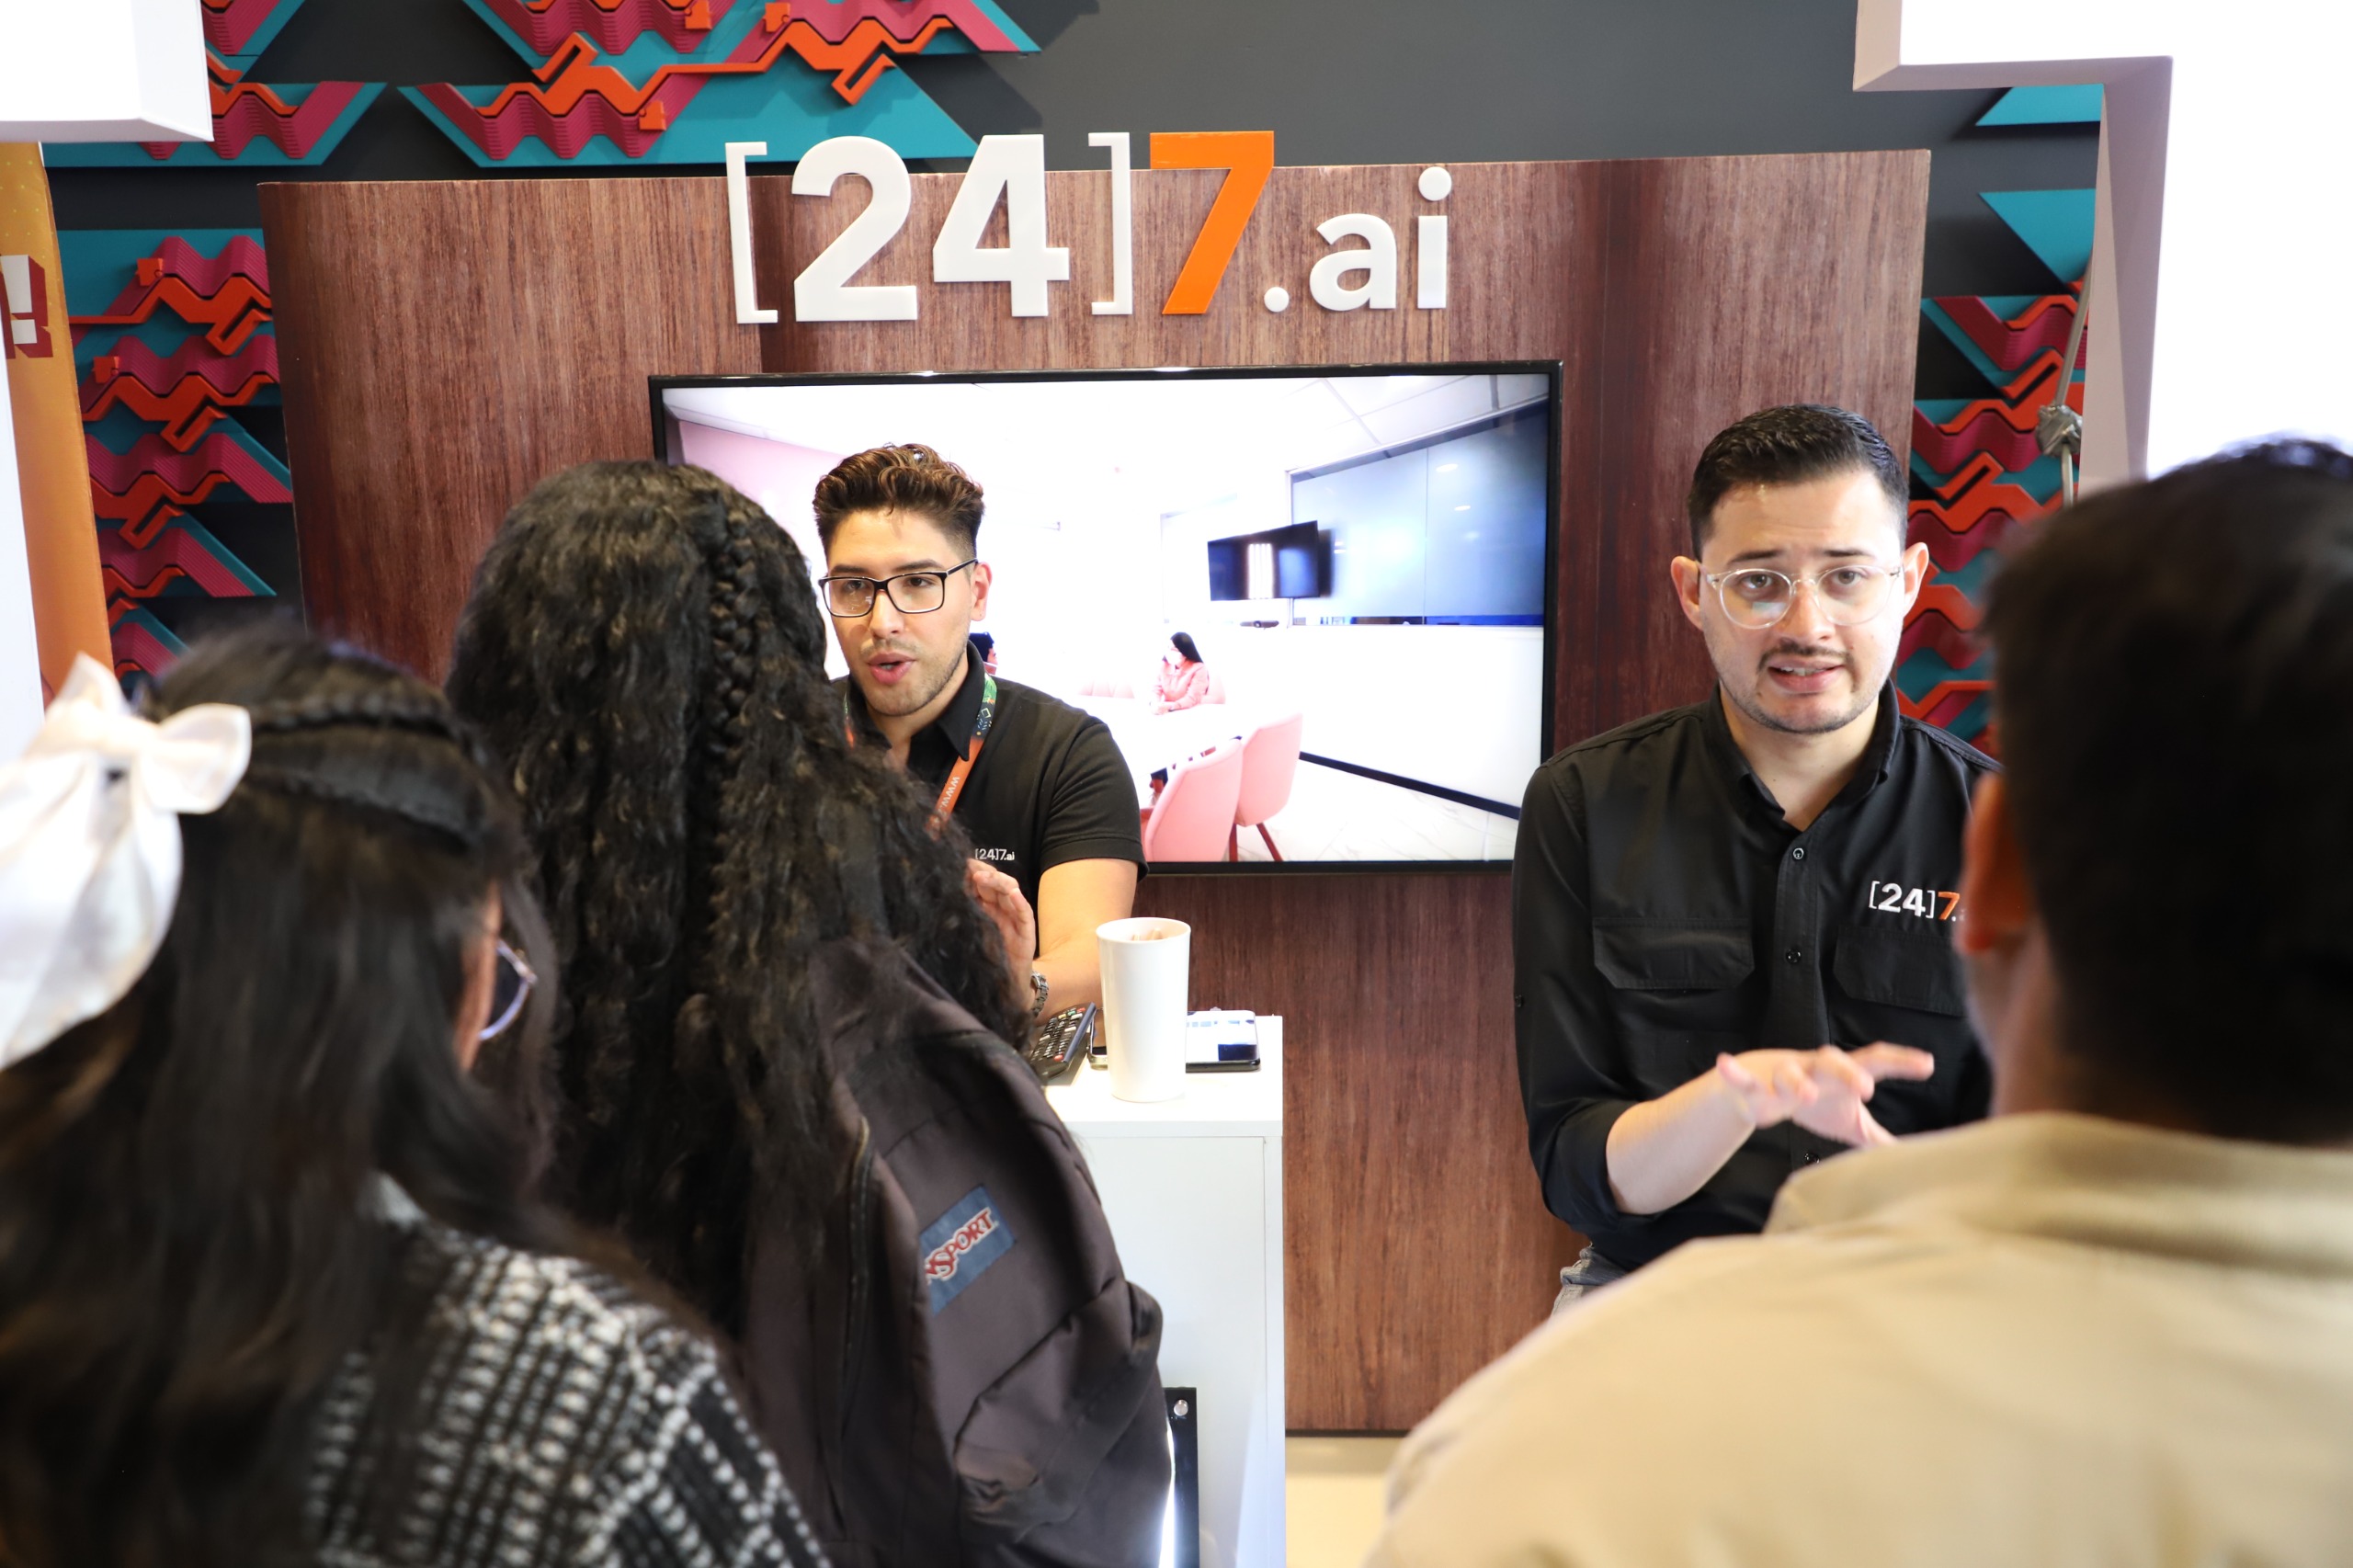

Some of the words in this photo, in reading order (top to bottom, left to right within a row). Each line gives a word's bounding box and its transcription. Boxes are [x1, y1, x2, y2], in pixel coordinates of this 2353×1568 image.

[725, 131, 1453, 324] [24]7.ai
[974, 847, 1015, 861] [24]7.ai
[1869, 881, 1965, 922] [24]7.
